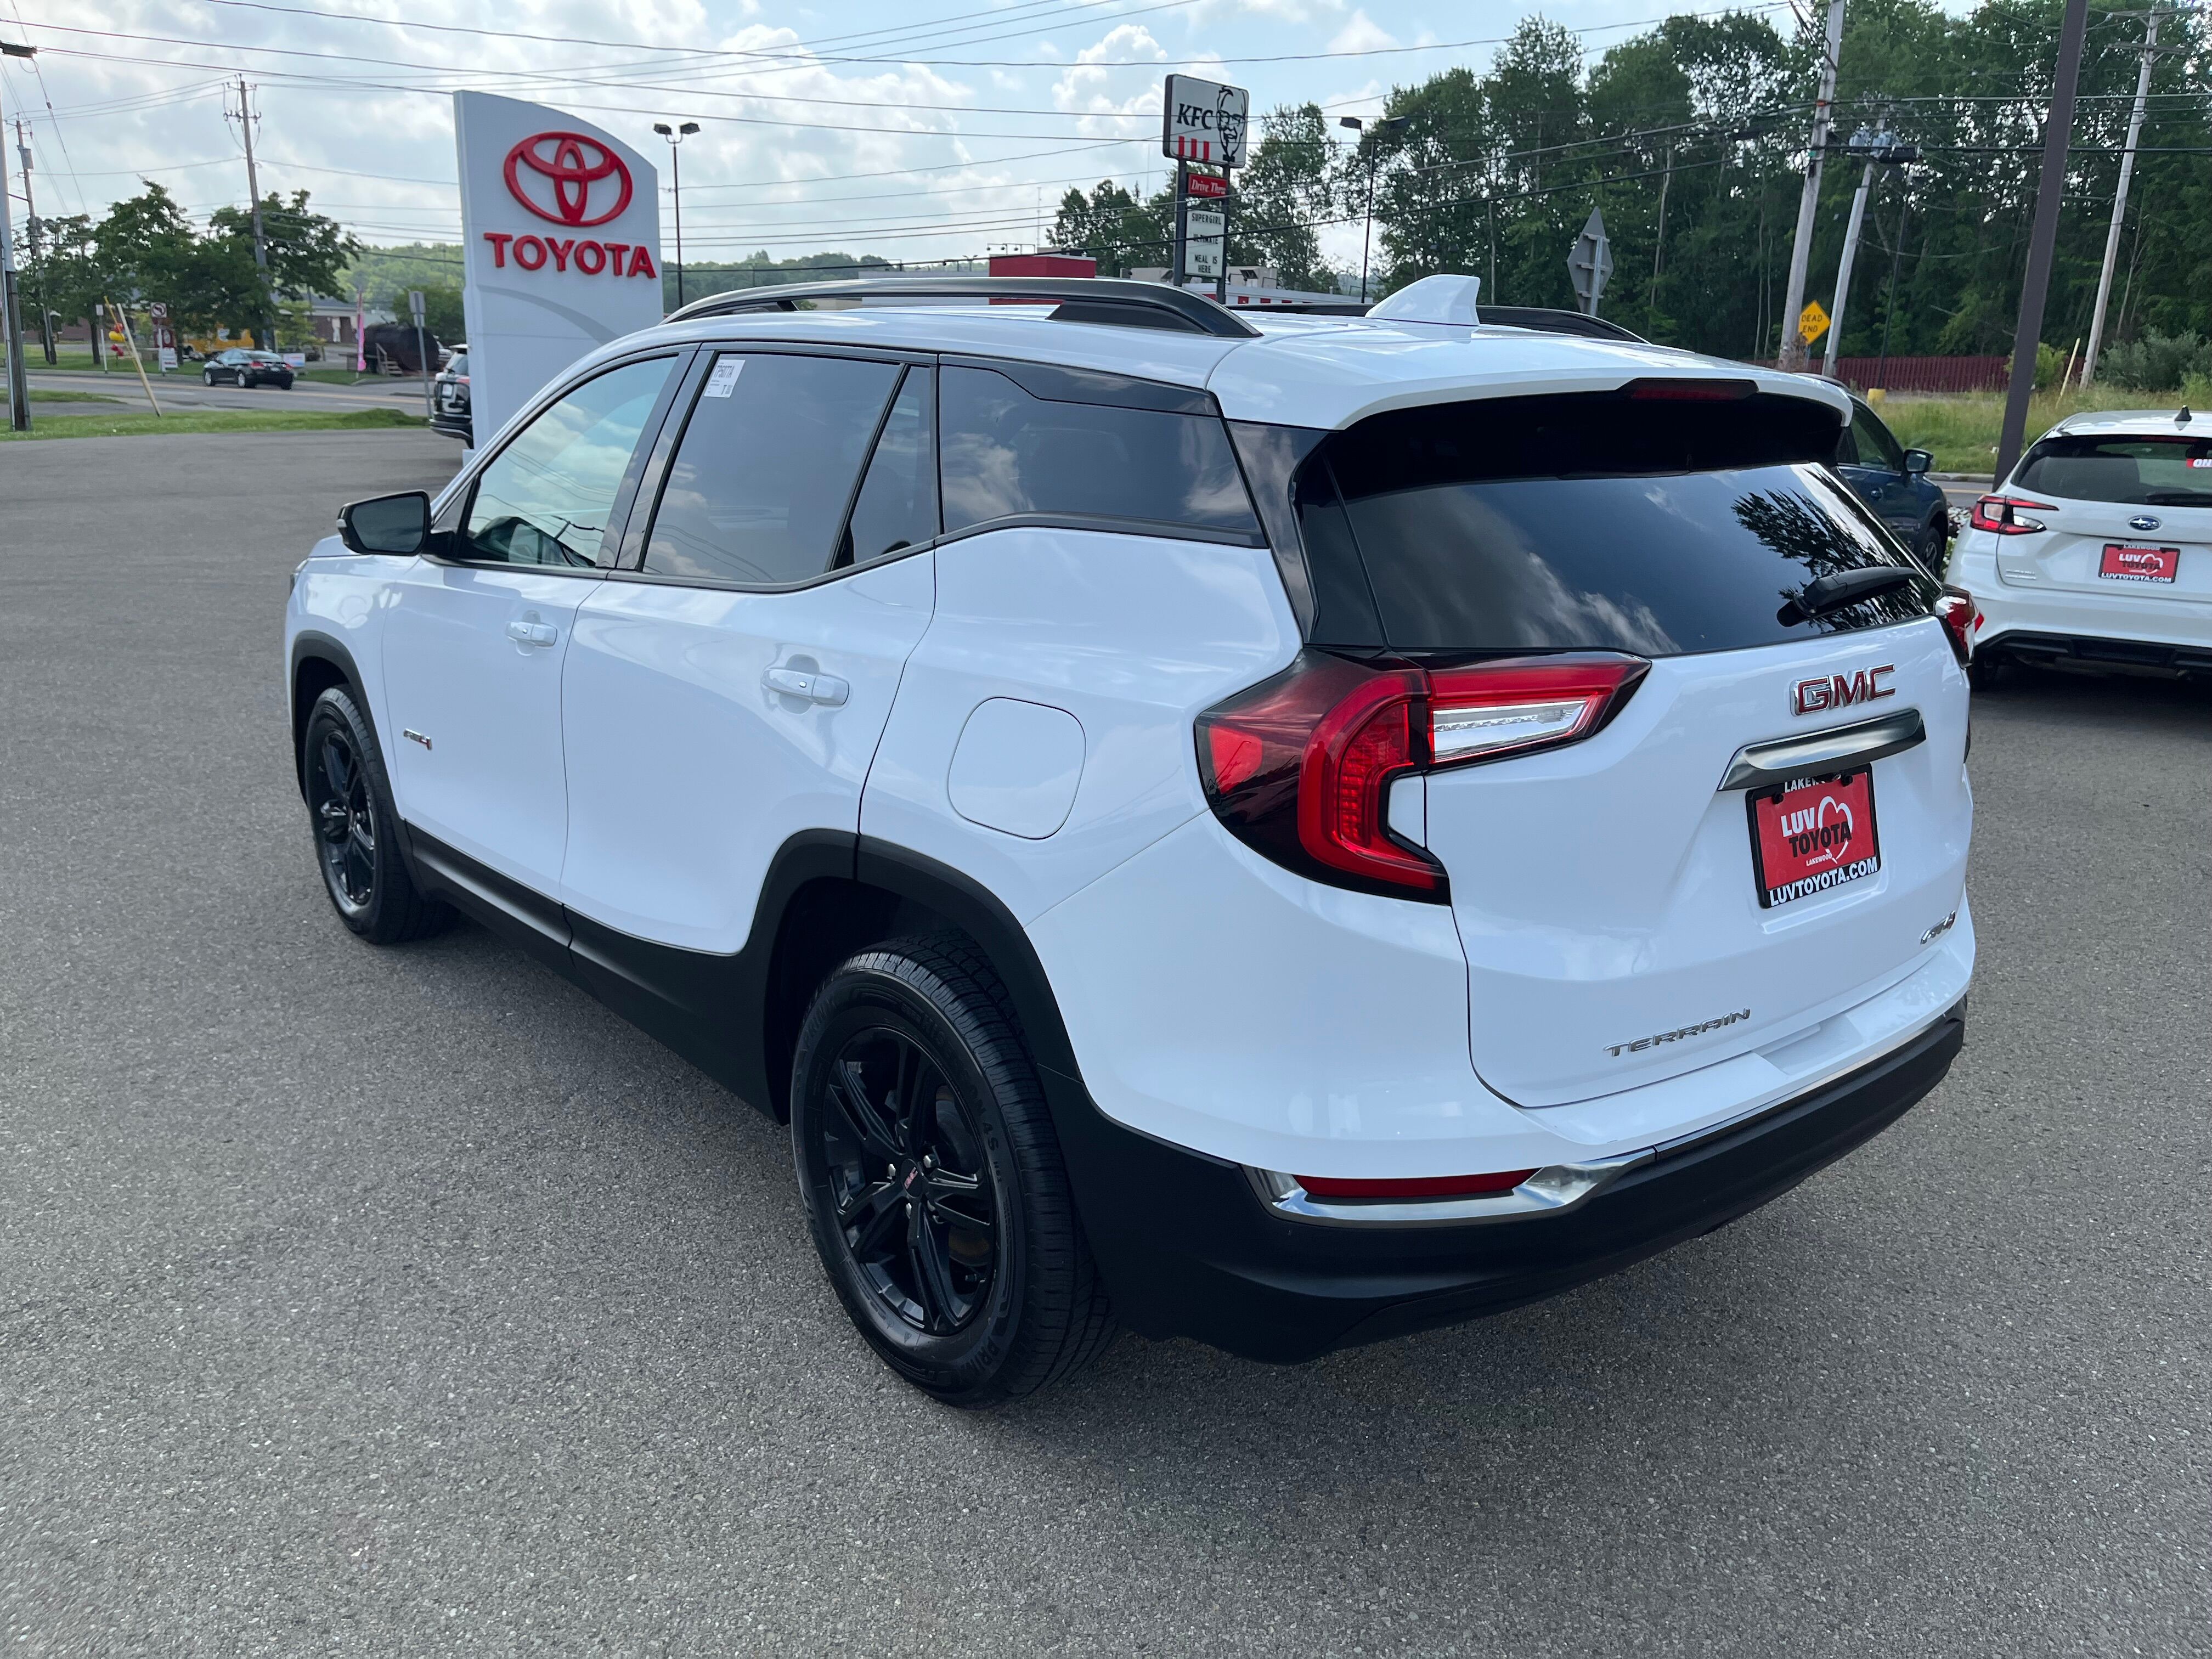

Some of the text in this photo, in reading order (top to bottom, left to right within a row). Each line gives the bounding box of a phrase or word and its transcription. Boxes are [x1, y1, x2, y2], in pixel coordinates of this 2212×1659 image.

[1176, 103, 1213, 129] KFC
[1191, 179, 1209, 192] Drive
[1192, 212, 1221, 225] SUPERGIRL
[483, 232, 657, 279] TOYOTA
[1194, 254, 1217, 264] MEAL IS
[1198, 264, 1211, 274] HERE
[1801, 314, 1822, 323] DEAD
[2119, 554, 2142, 562] LUV
[2122, 561, 2161, 570] TOYOTA
[2101, 572, 2172, 583] LUVTOYOTA.COM
[1790, 663, 1896, 716] GMC
[1781, 807, 1815, 838] LUV
[1789, 821, 1852, 857] TOYOTA
[1806, 853, 1832, 866] LAKEWOOD
[1769, 856, 1878, 906] LUVTOYOTA.COM
[1603, 1007, 1751, 1057] TERRAIN
